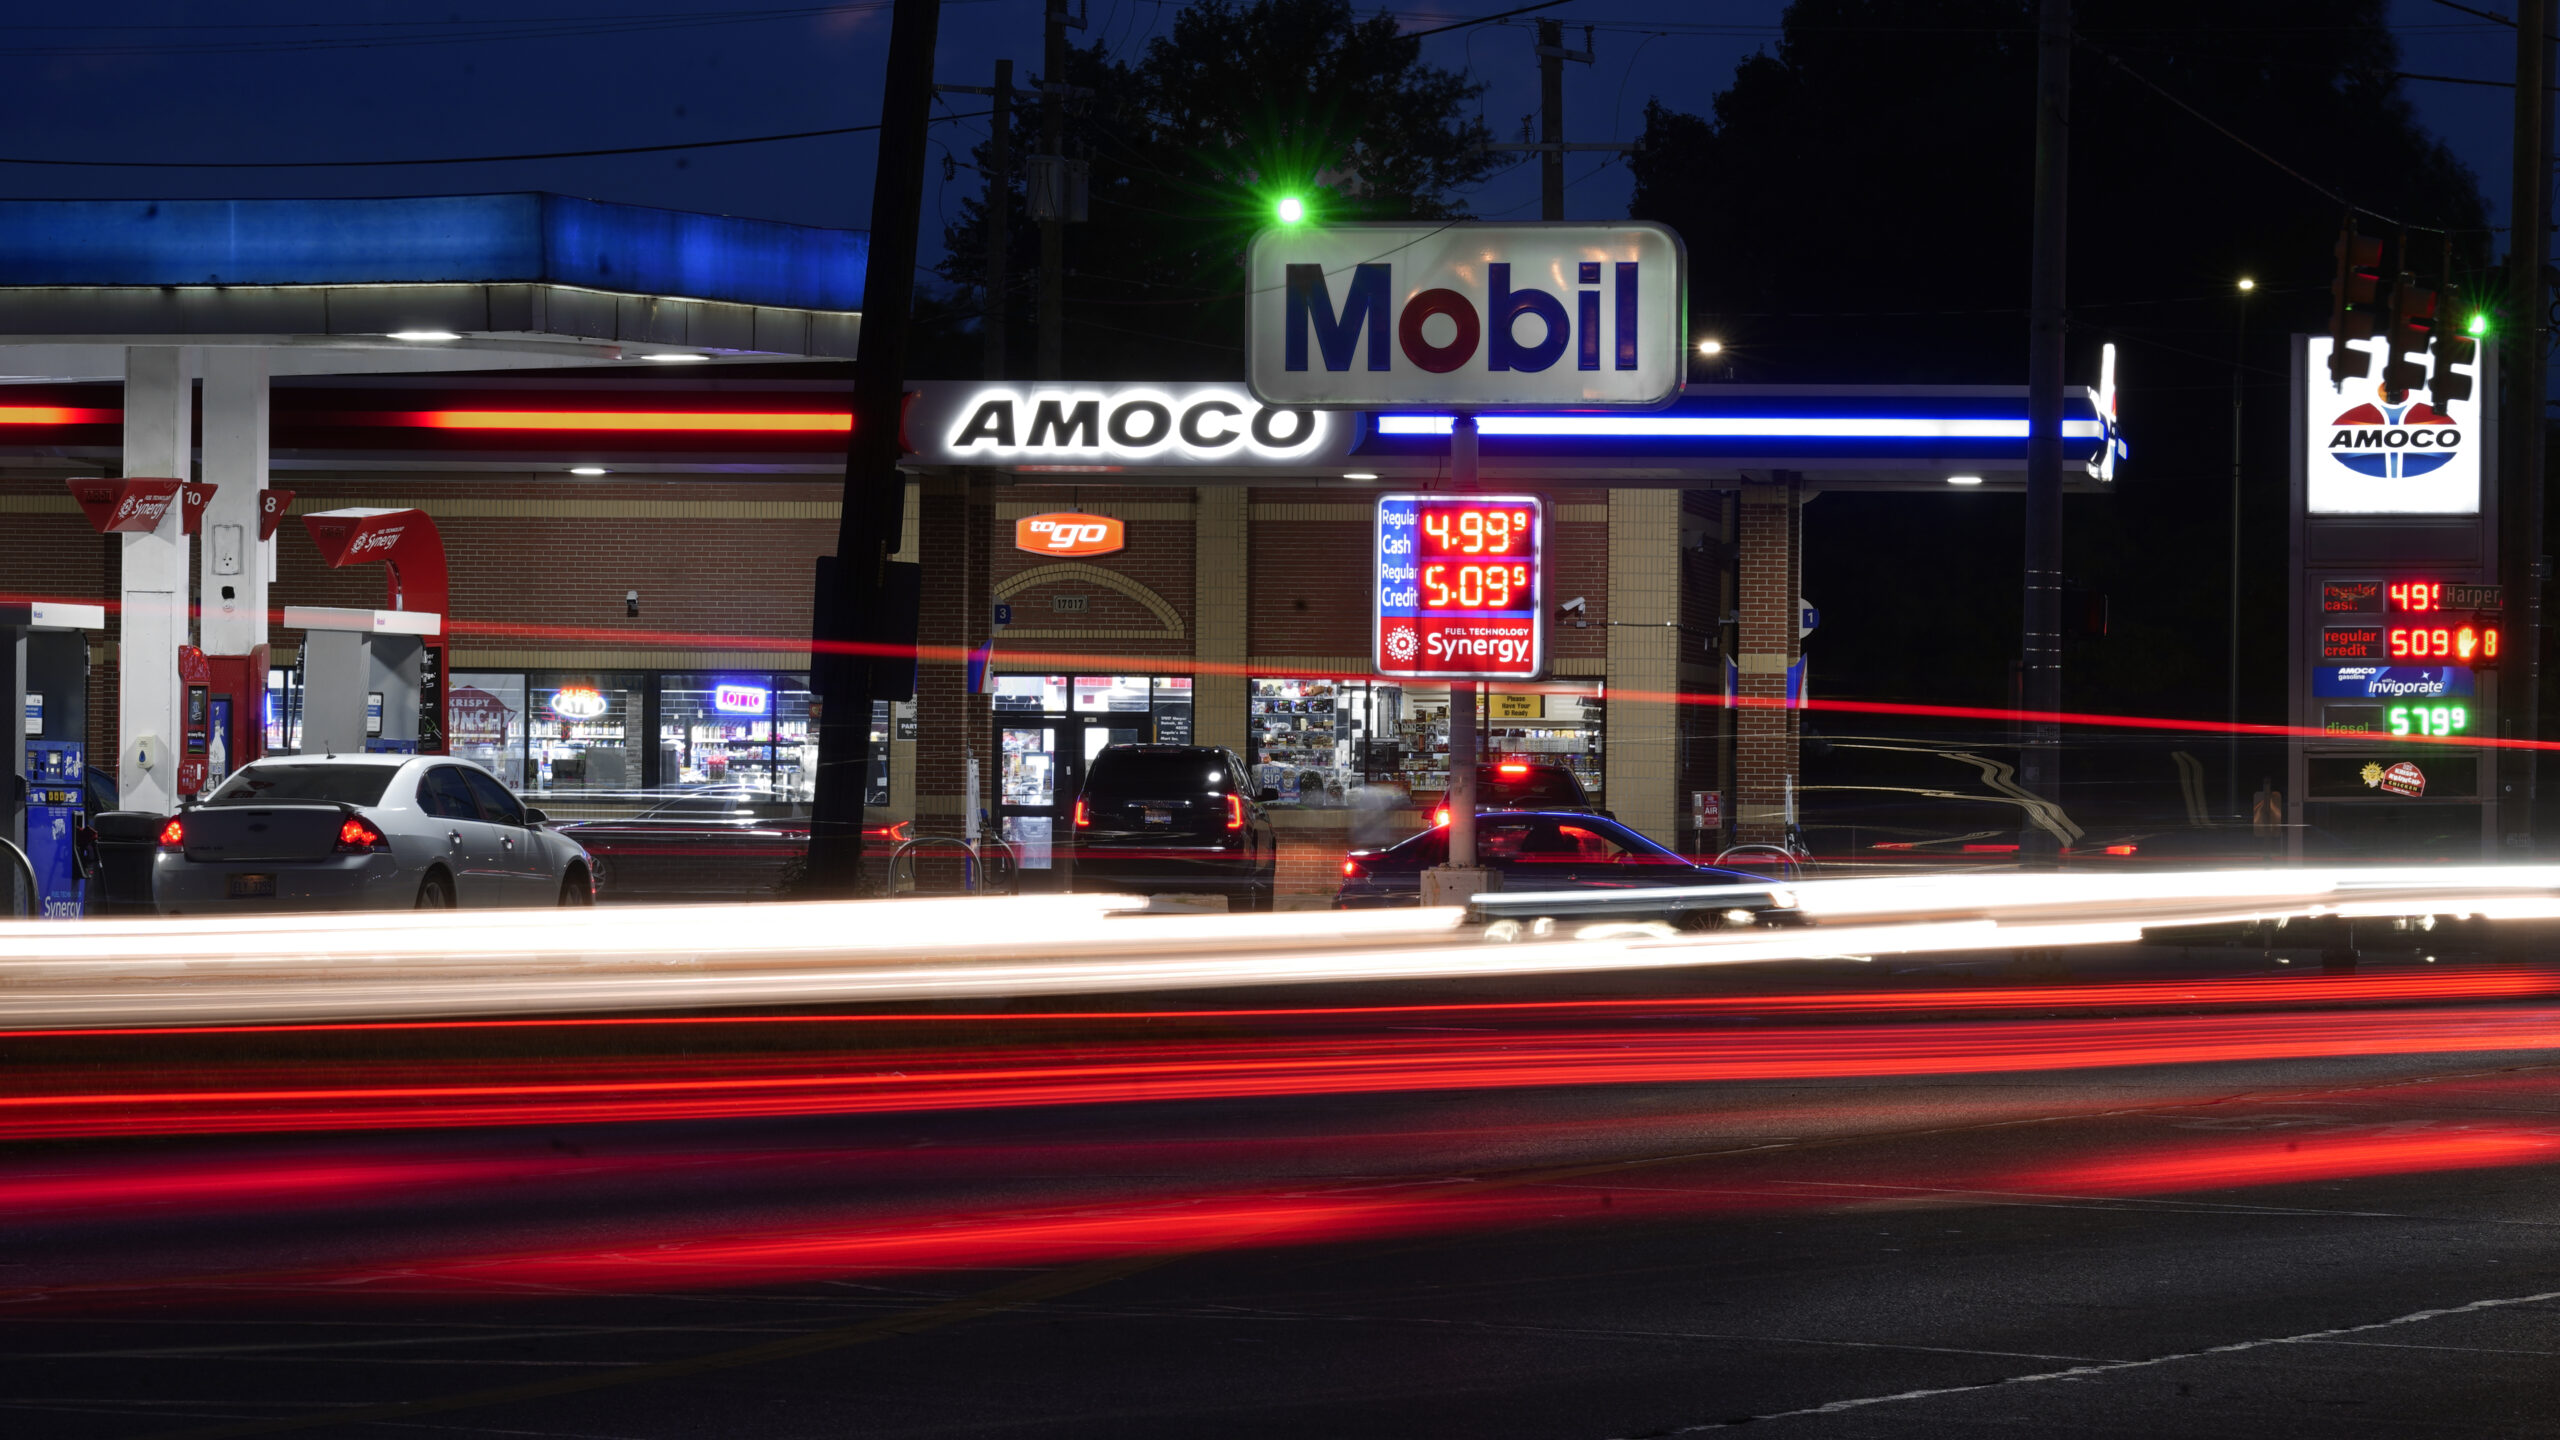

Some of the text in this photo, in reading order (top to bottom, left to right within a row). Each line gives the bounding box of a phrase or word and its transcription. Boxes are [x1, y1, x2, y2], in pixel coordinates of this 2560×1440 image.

[1286, 262, 1639, 373] Mobil
[953, 400, 1316, 448] AMOCO
[2328, 429, 2462, 448] AMOCO
[186, 491, 201, 506] 10
[264, 497, 277, 512] 8
[131, 498, 167, 520] Synergy
[1382, 508, 1419, 530] Regular
[1030, 521, 1108, 548] to go
[364, 533, 401, 553] Synergy
[1382, 534, 1411, 554] Cash
[1382, 563, 1419, 584] Regular
[1057, 600, 1084, 609] 17017
[1382, 587, 1419, 607] Credit
[2447, 587, 2500, 607] Harper
[1000, 608, 1007, 619] 3
[1808, 612, 1814, 623] 1
[1445, 627, 1529, 636] FUEL TECHNOLOGY
[2324, 630, 2377, 645] regular
[1427, 632, 1530, 663] Synergy
[2324, 644, 2367, 657] credit
[2338, 667, 2376, 675] AMOCO
[2368, 680, 2443, 697] Invigorate
[449, 698, 490, 707] KRISPY
[449, 707, 517, 732] UNCHY
[2326, 722, 2369, 735] diesel
[1264, 774, 1280, 784] SIP
[2394, 768, 2419, 778] KRISPY
[2388, 781, 2418, 791] CHICKEN
[1705, 807, 1718, 815] AIR
[44, 896, 82, 920] Synergy
